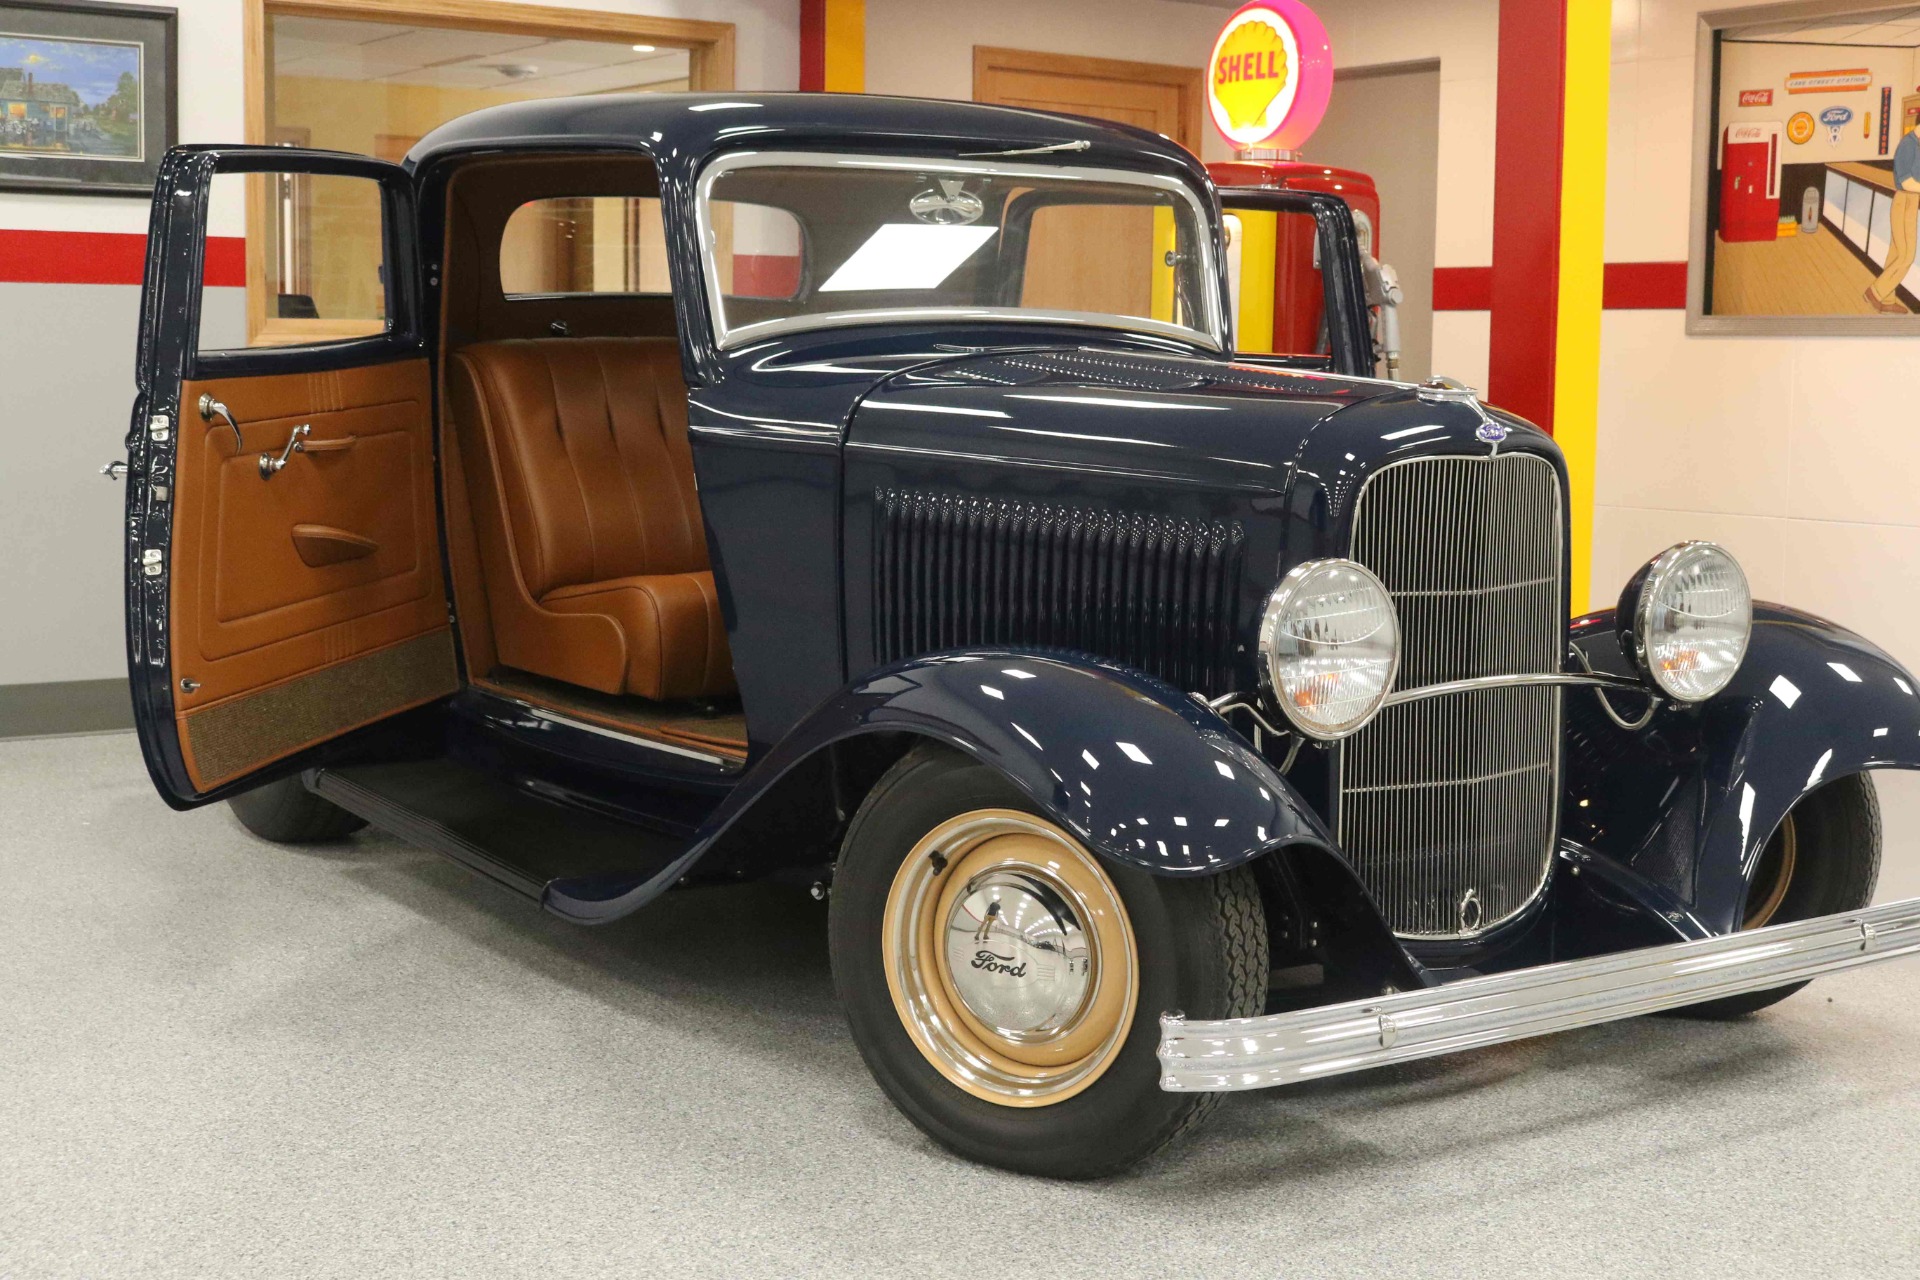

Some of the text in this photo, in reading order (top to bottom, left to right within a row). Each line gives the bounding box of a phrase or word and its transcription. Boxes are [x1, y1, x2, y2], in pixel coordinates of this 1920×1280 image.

[1218, 51, 1279, 84] SHELL
[1823, 109, 1849, 122] Ford
[971, 950, 1026, 977] Ford
